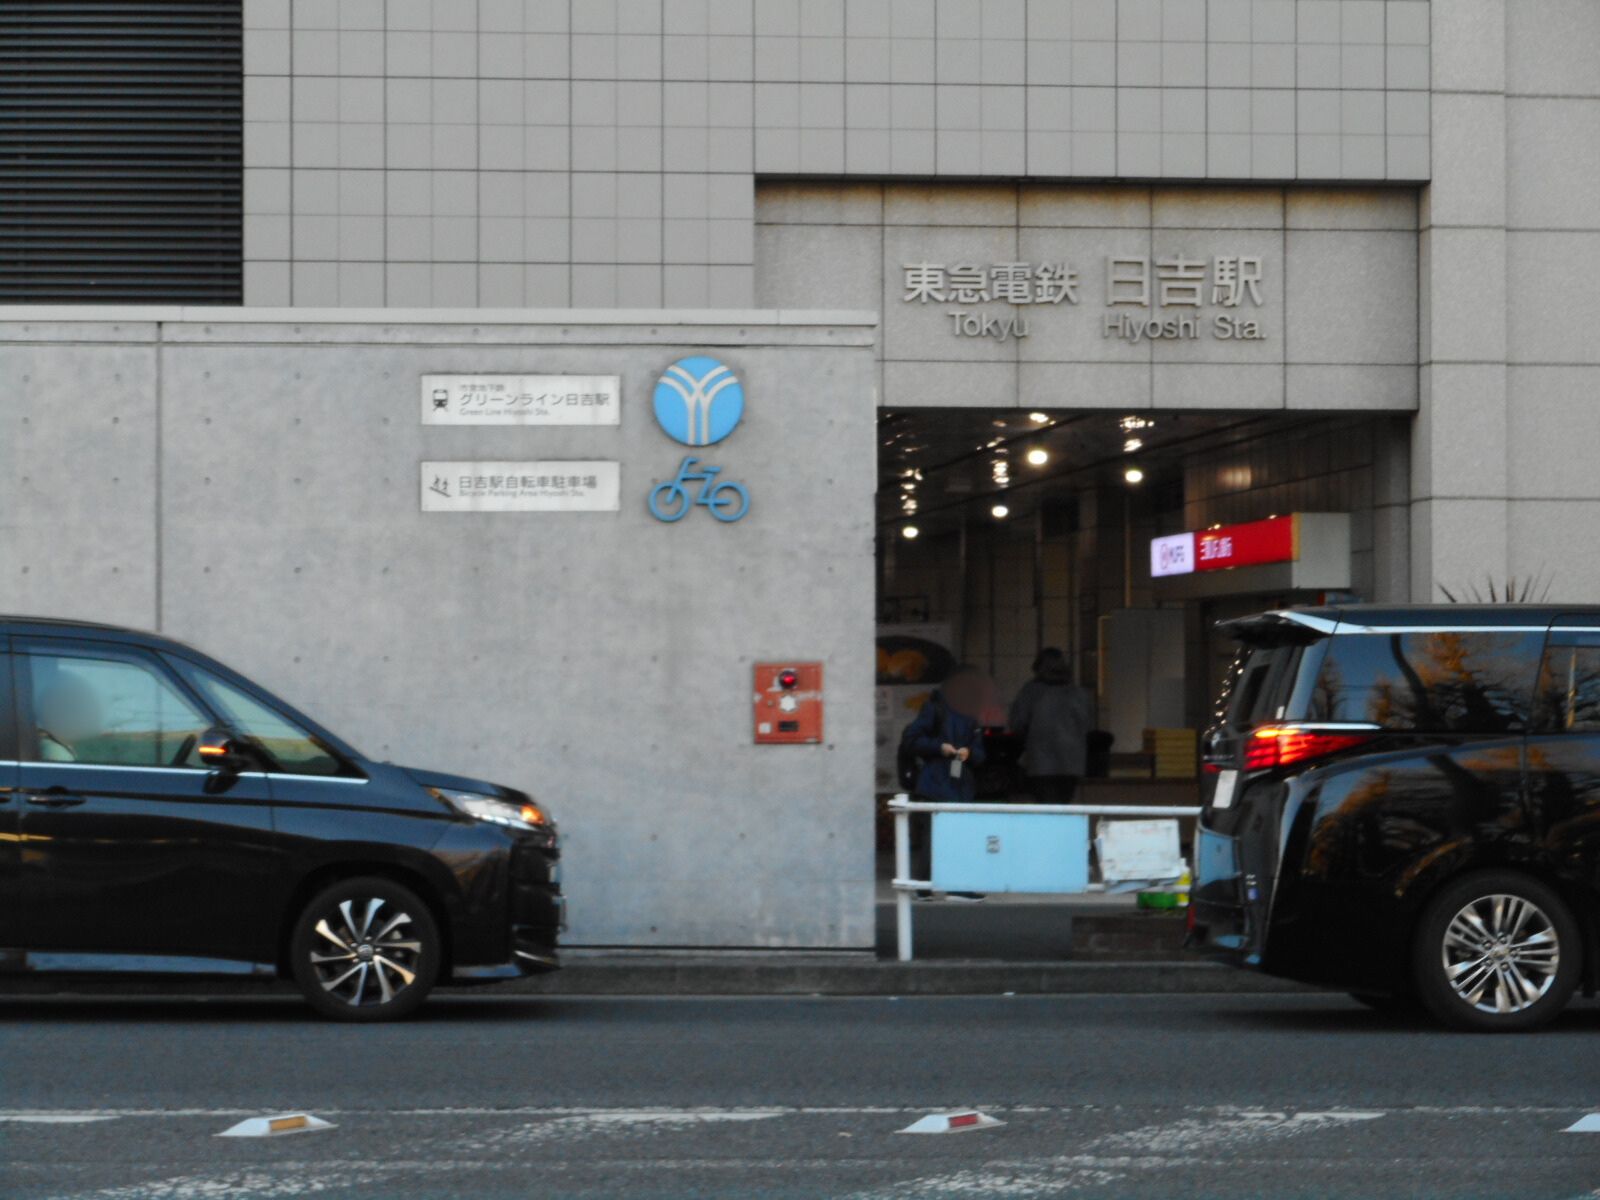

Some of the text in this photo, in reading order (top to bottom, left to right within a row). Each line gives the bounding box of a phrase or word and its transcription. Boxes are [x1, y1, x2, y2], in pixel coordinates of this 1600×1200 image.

[903, 254, 1264, 307] 東急電鉄 日吉駅
[948, 312, 1267, 343] Tokyu Hiyoshi Sta.
[460, 393, 609, 406] グリーンライン日吉駅
[459, 475, 597, 489] 日吉駅自転車駐車場
